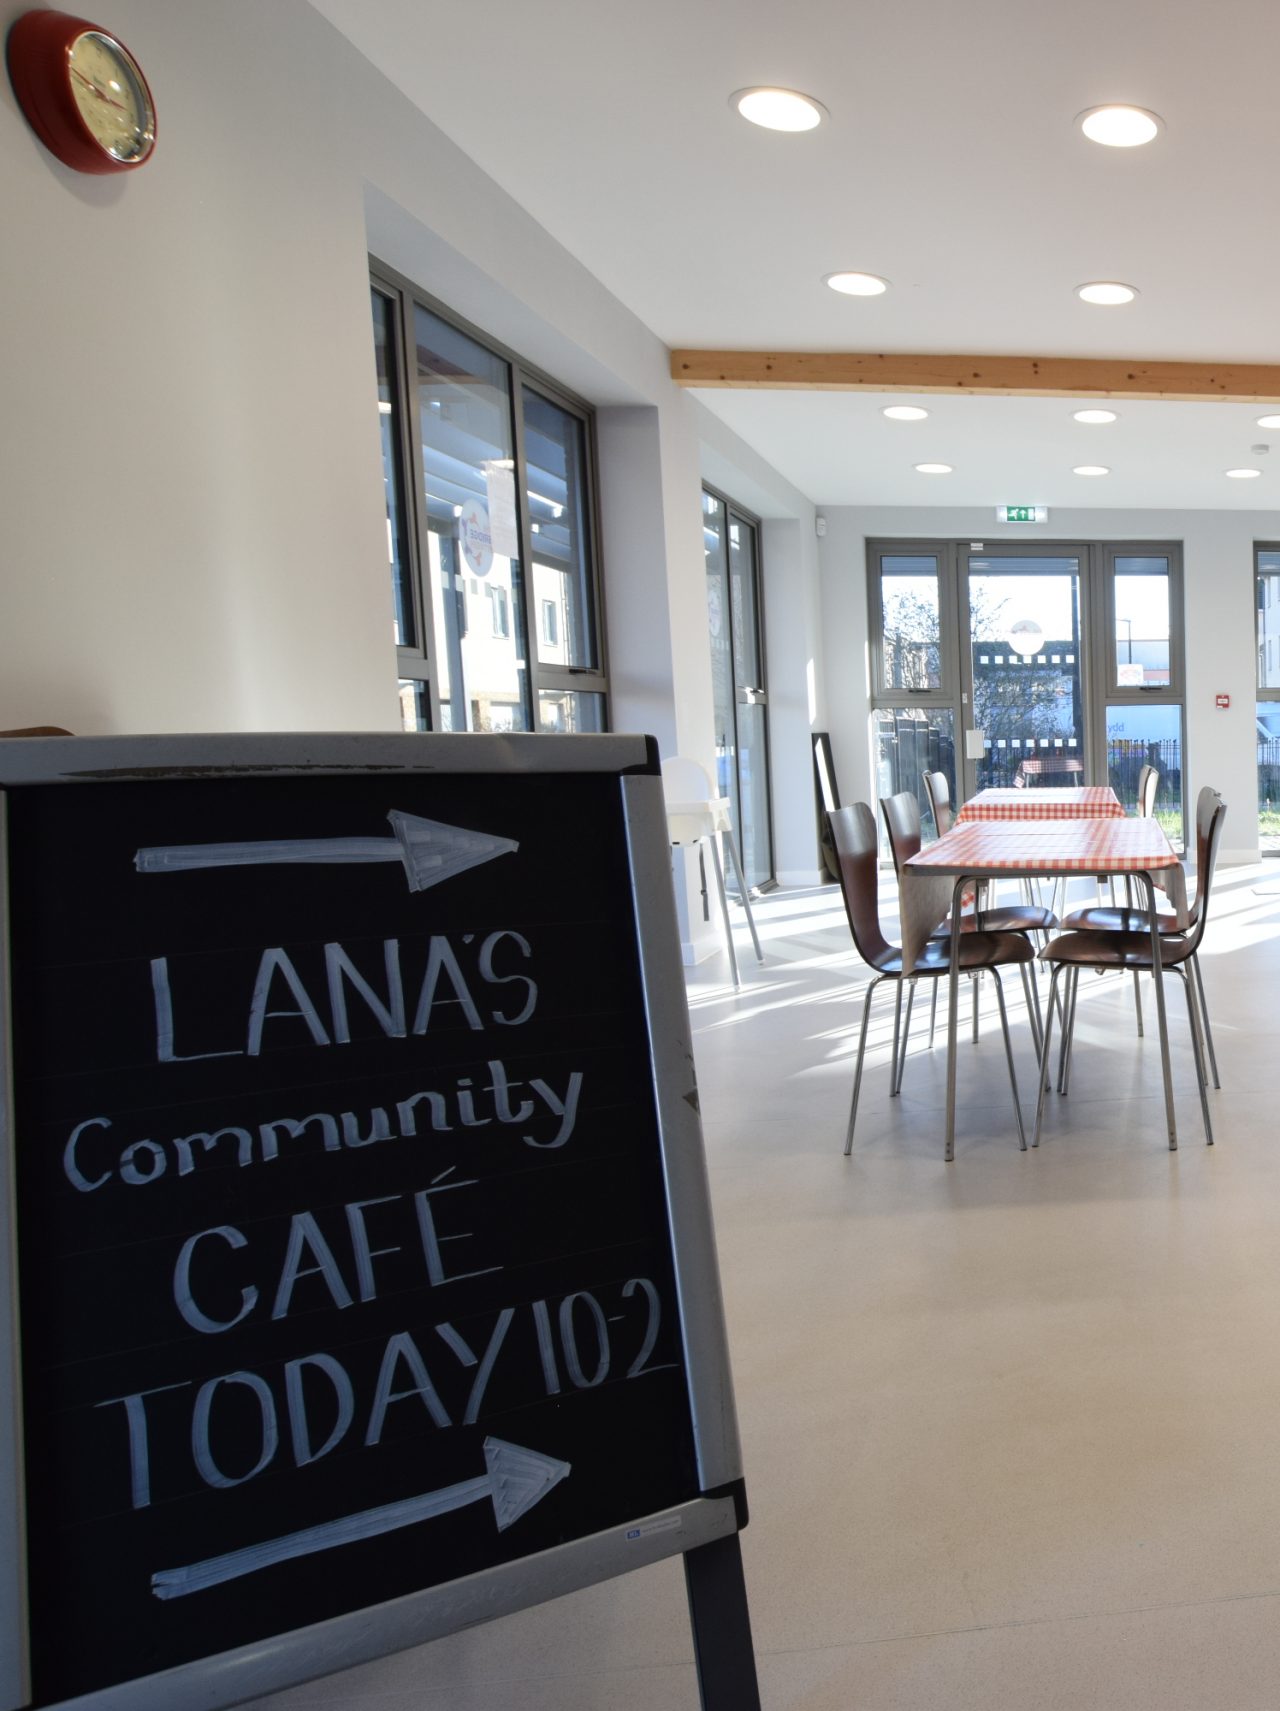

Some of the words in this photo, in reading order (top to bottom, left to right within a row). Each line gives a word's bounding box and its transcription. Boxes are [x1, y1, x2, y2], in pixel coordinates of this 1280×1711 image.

[150, 930, 538, 1062] LANA'S
[63, 1060, 584, 1192] Community
[173, 1166, 504, 1334] CAFÉ
[94, 1307, 516, 1509] TODAY
[532, 1278, 680, 1394] 10-2
